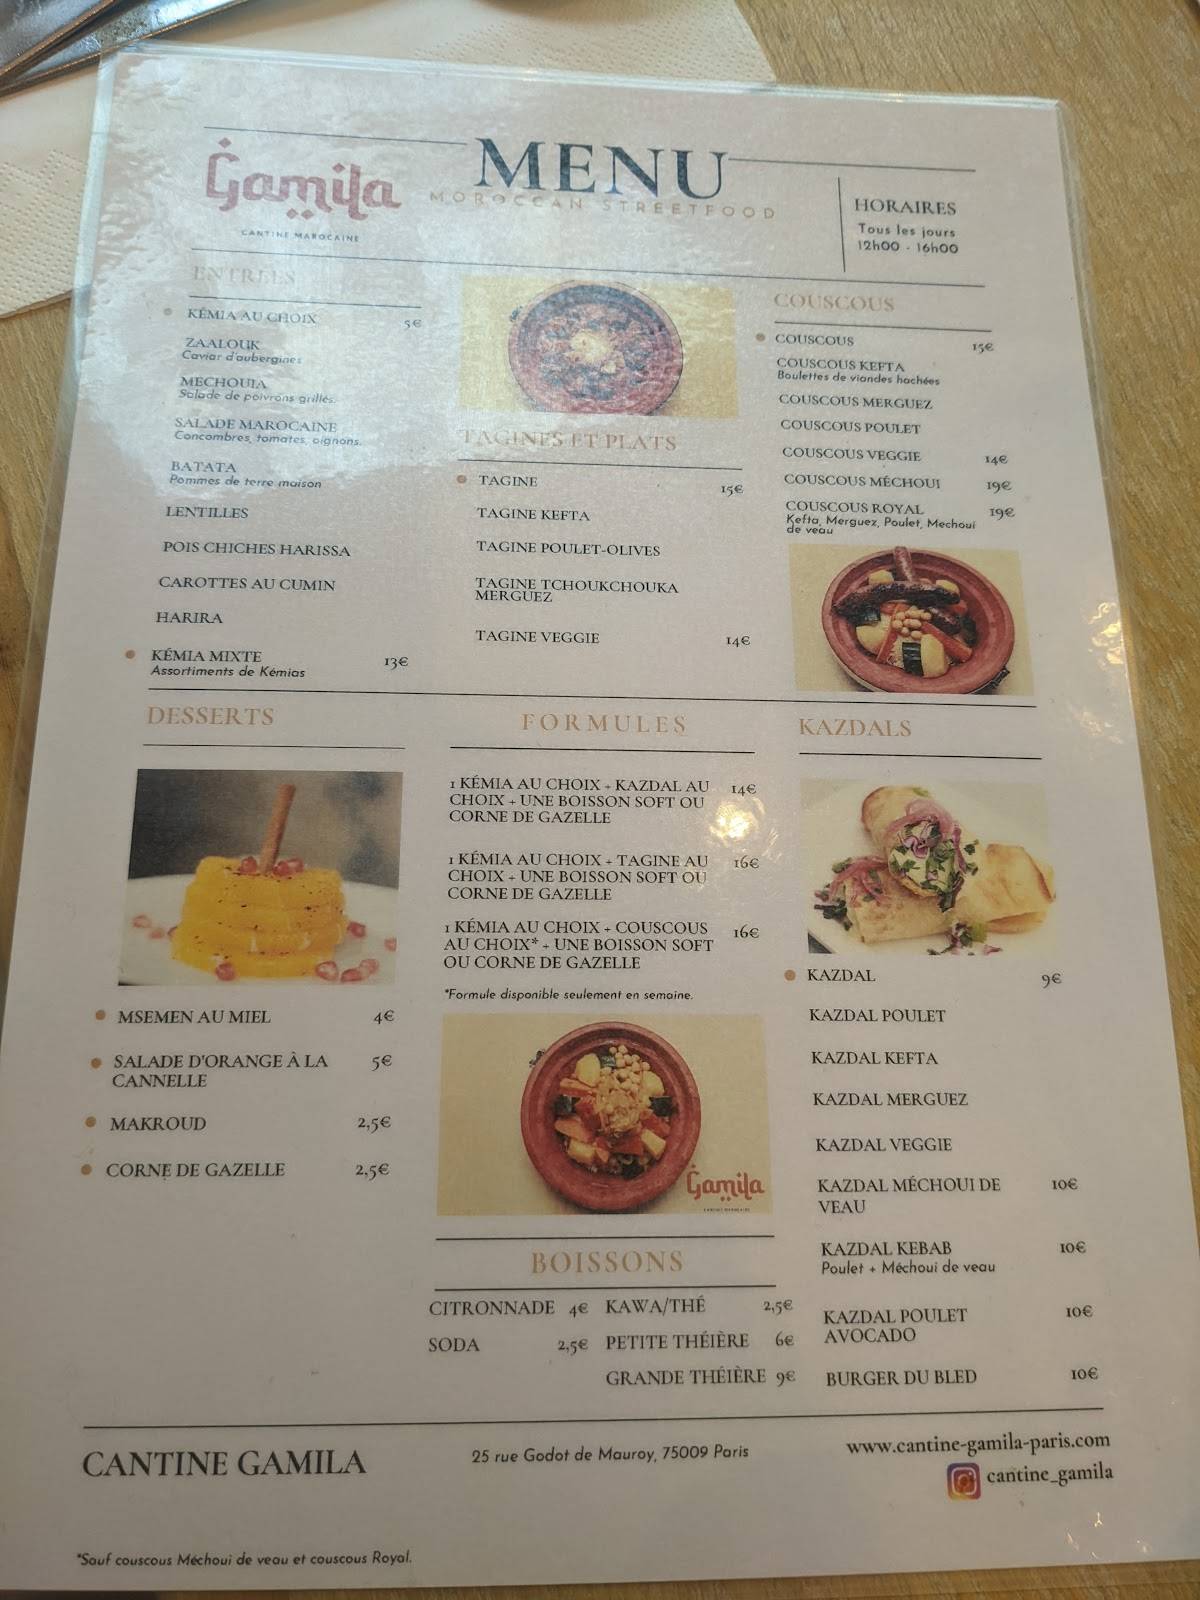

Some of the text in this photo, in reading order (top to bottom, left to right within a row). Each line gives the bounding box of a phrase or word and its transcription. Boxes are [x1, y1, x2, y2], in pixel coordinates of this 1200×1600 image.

[474, 138, 728, 200] MENU
[430, 191, 775, 219] MOROCCAN STREETFOOD
[855, 199, 957, 215] HORAIRES
[859, 223, 955, 238] Tous les jours
[858, 241, 900, 251] 12h00
[917, 243, 958, 254] 16h00
[774, 293, 895, 312] COUSCOUS
[188, 308, 422, 328] KÉMIA AU CHOIX 5€
[185, 338, 260, 350] ZAALOUK
[775, 334, 854, 346] COUSCOUS
[777, 371, 940, 386] Boulettes de viandes hachées
[175, 417, 338, 433] SALADE MAROCAINE
[174, 430, 252, 444] Concombres,
[256, 434, 306, 446] tomates,
[462, 430, 677, 451] TAGINES ET PLATS
[782, 447, 1008, 465] COUSCOUS VEGGIE 14€
[170, 460, 236, 473] BATATA
[170, 474, 322, 488] Pommes de terre maison
[479, 475, 743, 497] TAGINE 15€
[166, 506, 248, 519] LENTILLES
[786, 501, 1015, 520] COUSCOUS ROYAL 19€
[786, 514, 975, 530] Kefta, Merguez, Poulet, Mechoui
[787, 524, 833, 535] de veau
[162, 542, 350, 556] POIS CHICHES HARISSA
[477, 540, 660, 557] TAGINE POULET-OLIVES
[476, 577, 679, 594] TAGINE TCHOUKCHOUKA
[475, 590, 552, 603] MERGUEZ
[156, 611, 223, 624] HARIRA
[151, 648, 408, 670] KÉMIA MIXTE 13€
[150, 666, 306, 678] Assortiments de Kémias
[147, 706, 274, 726] DESSERTS
[521, 713, 688, 735] FORMULES
[799, 718, 912, 738] KAZDALS
[460, 775, 513, 790] KÉMIA
[517, 778, 542, 790] AU
[546, 779, 600, 791] CHOIX
[615, 780, 682, 792] KAZDAL
[685, 781, 709, 792] AU
[731, 784, 756, 796] 14€
[450, 794, 504, 806] CHOIX
[520, 795, 554, 806] UNE
[559, 796, 632, 808] BOISSON
[635, 797, 676, 809] SOFT
[679, 797, 705, 809] OU
[449, 810, 612, 824] CORNE DE GAZELLE
[807, 969, 1062, 988] KAZDAL 9€
[501, 989, 559, 1002] disponible
[563, 990, 621, 1000] seulement
[625, 992, 639, 1000] en
[643, 990, 693, 1000] semaine.
[117, 1010, 395, 1024] MSEMEN AU MIEL 4€
[113, 1051, 392, 1071] SALADE D'ORANGE À LA 5€
[112, 1073, 207, 1088] CANNELLE
[110, 1116, 391, 1133] MAKROUD 2,5€
[817, 1176, 1078, 1193] KAZDAL MÉCHOUI DE 10€
[818, 1200, 866, 1214] VEAU
[532, 1250, 684, 1275] BOISSONS
[821, 1261, 864, 1275] Poulet
[882, 1260, 938, 1274] Méchoui
[942, 1260, 960, 1273] de
[964, 1263, 996, 1273] veau
[429, 1300, 588, 1318] CITRONNADE 4€
[605, 1296, 793, 1315] KAWA/THÉ 2,5€
[605, 1366, 796, 1387] GRANDE THÉIÈRE 9€
[826, 1368, 1098, 1387] BURGER DU BLED 10€
[846, 1432, 1110, 1457] www.cantine-gamila-paris.com
[471, 1444, 749, 1464] 25 rue Godot de Mauroy, 75009 Paris
[83, 1450, 366, 1477] CANTINE GAMILA
[986, 1460, 1114, 1487] cantine_gamila
[116, 1556, 173, 1567] couscous
[177, 1554, 232, 1566] Méchoui
[236, 1552, 253, 1565] de
[258, 1555, 289, 1565] veau
[293, 1554, 306, 1565] et
[311, 1553, 367, 1565] couscous
[372, 1550, 412, 1566] Royal.
